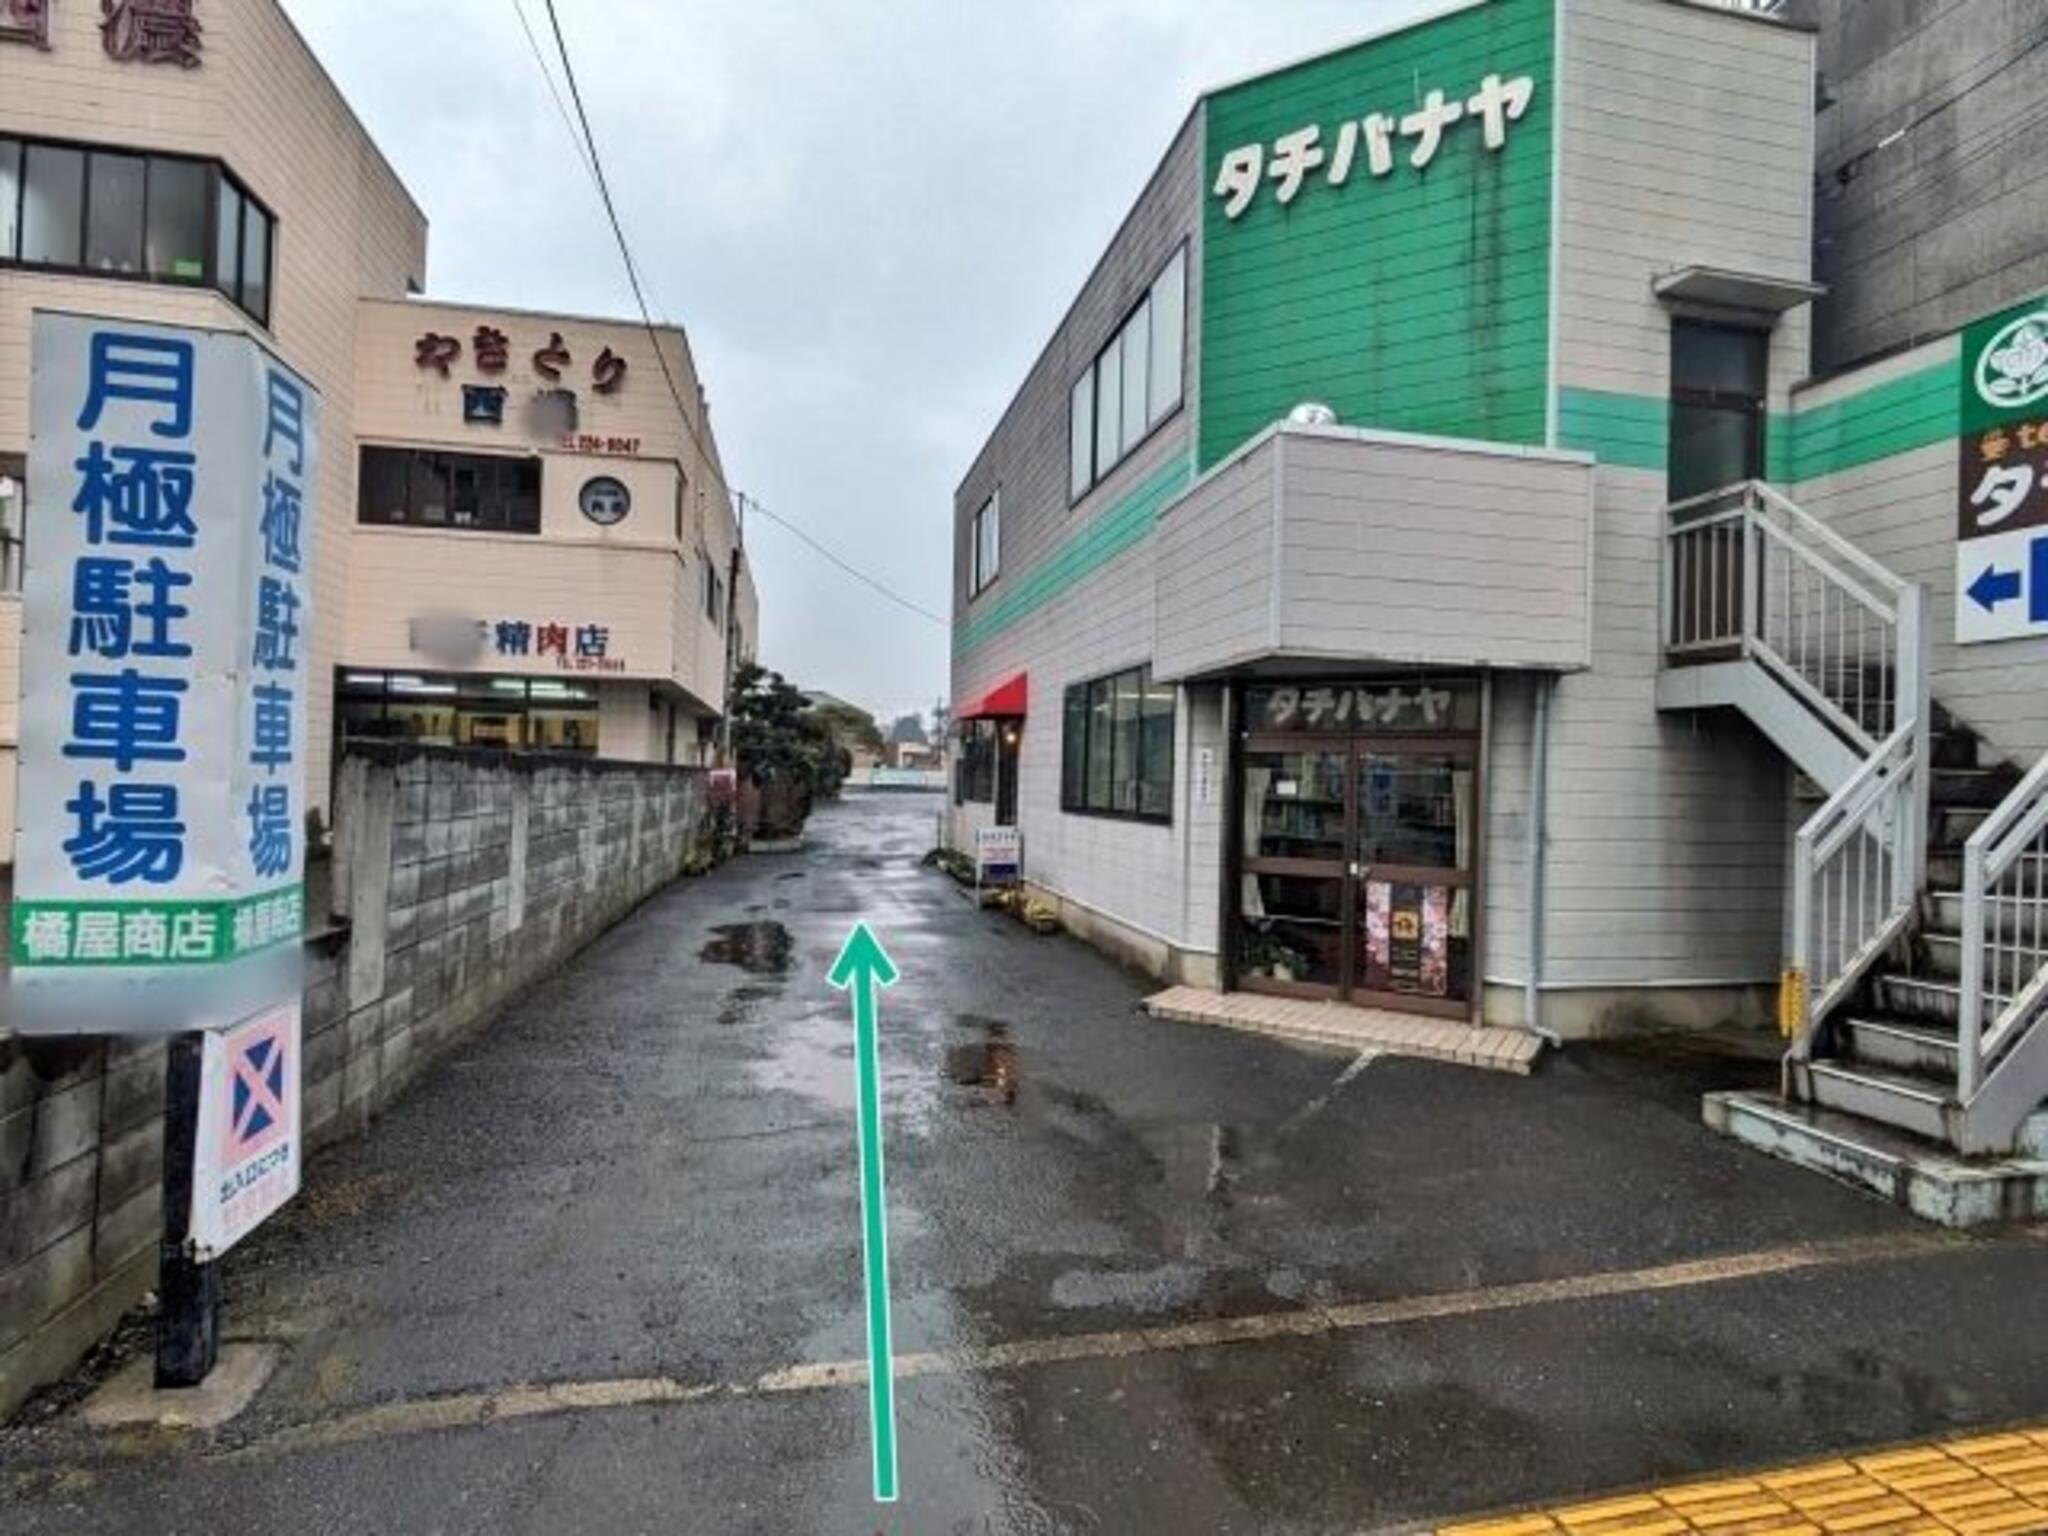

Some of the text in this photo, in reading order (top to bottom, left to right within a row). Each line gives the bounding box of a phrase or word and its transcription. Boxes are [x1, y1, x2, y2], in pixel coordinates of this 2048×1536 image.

[1212, 73, 1534, 219] タチバナヤ
[415, 326, 627, 396] やきとり
[1970, 463, 2048, 526] タ
[62, 331, 198, 884] 月極駐車場
[248, 367, 303, 878] 月極駐車場
